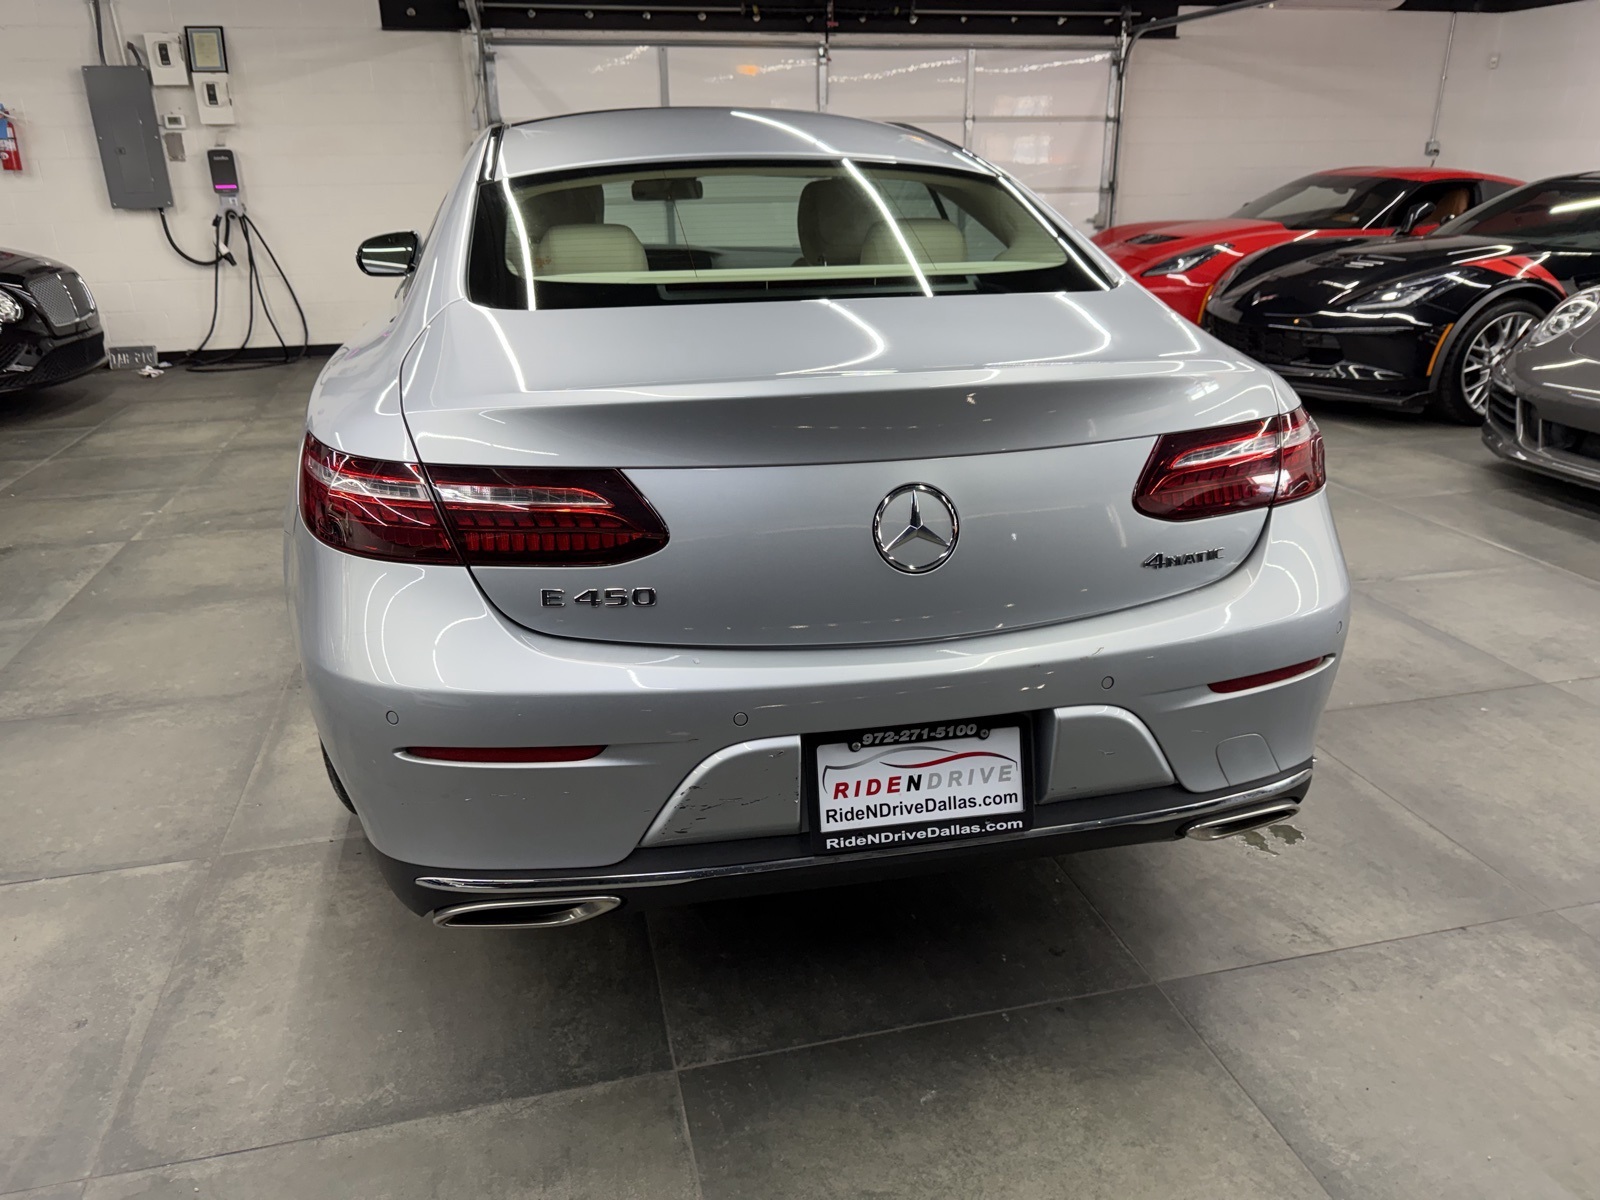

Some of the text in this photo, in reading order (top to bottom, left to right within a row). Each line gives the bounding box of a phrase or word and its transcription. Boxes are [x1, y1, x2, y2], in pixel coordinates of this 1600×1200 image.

[540, 587, 657, 608] E 450
[861, 723, 978, 746] 972-271-5100
[825, 791, 1019, 824] RideNDriveDallas.com
[826, 818, 1024, 850] RideNDriveDallas.com
